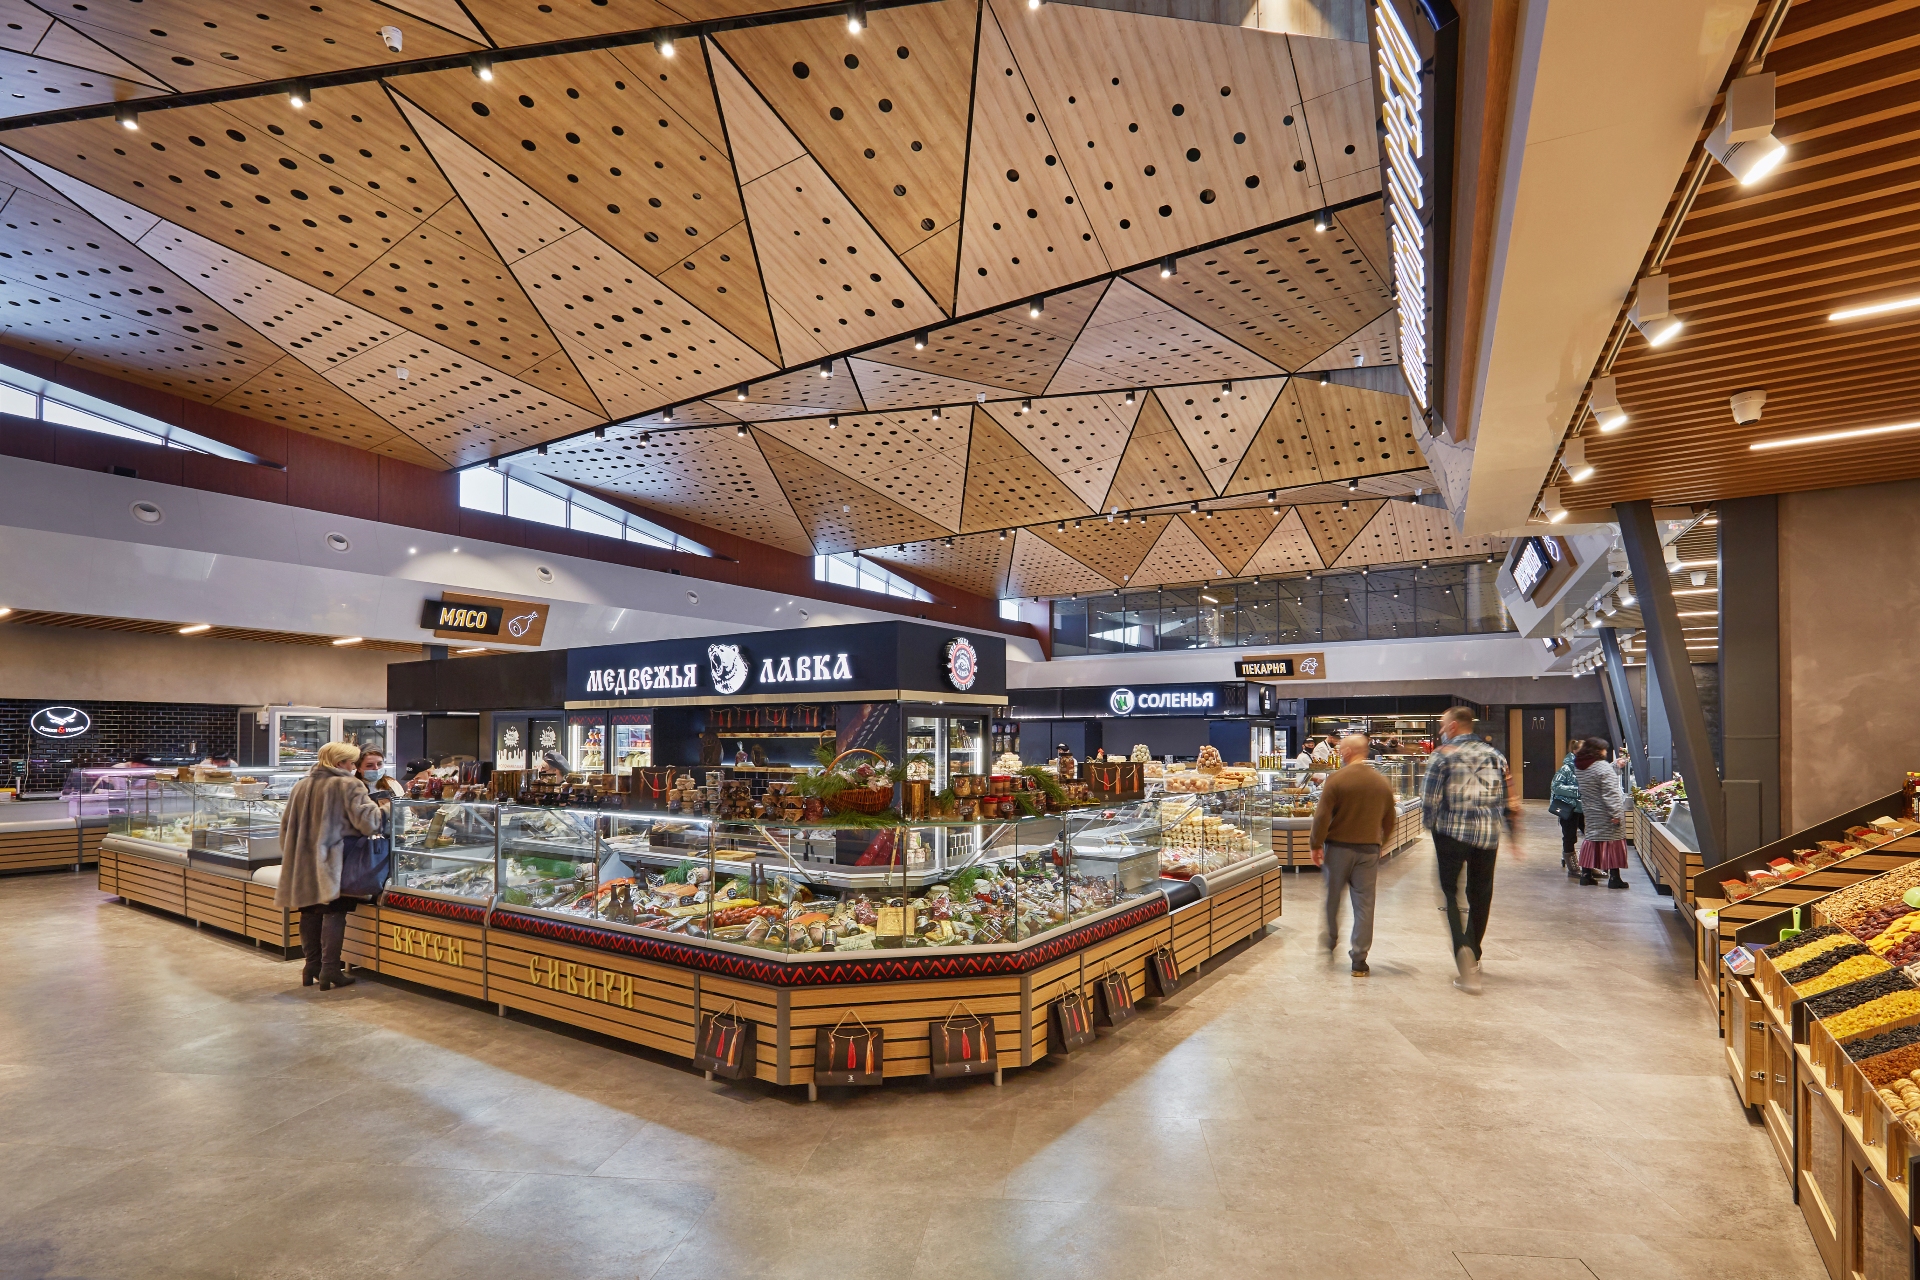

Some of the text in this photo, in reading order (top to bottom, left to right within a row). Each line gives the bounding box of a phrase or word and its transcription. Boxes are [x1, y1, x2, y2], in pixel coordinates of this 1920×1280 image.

[1374, 0, 1423, 209] ОРЕХИ
[439, 606, 488, 629] МЯСО
[586, 653, 853, 696] МЕДВЕЖЬЯ ЛАВКА
[1241, 662, 1287, 675] ПЕКАРНЯ
[1138, 692, 1214, 708] СОЛЕНЬЯ
[392, 924, 634, 1009] ВКУСЫ СИБИРИ
